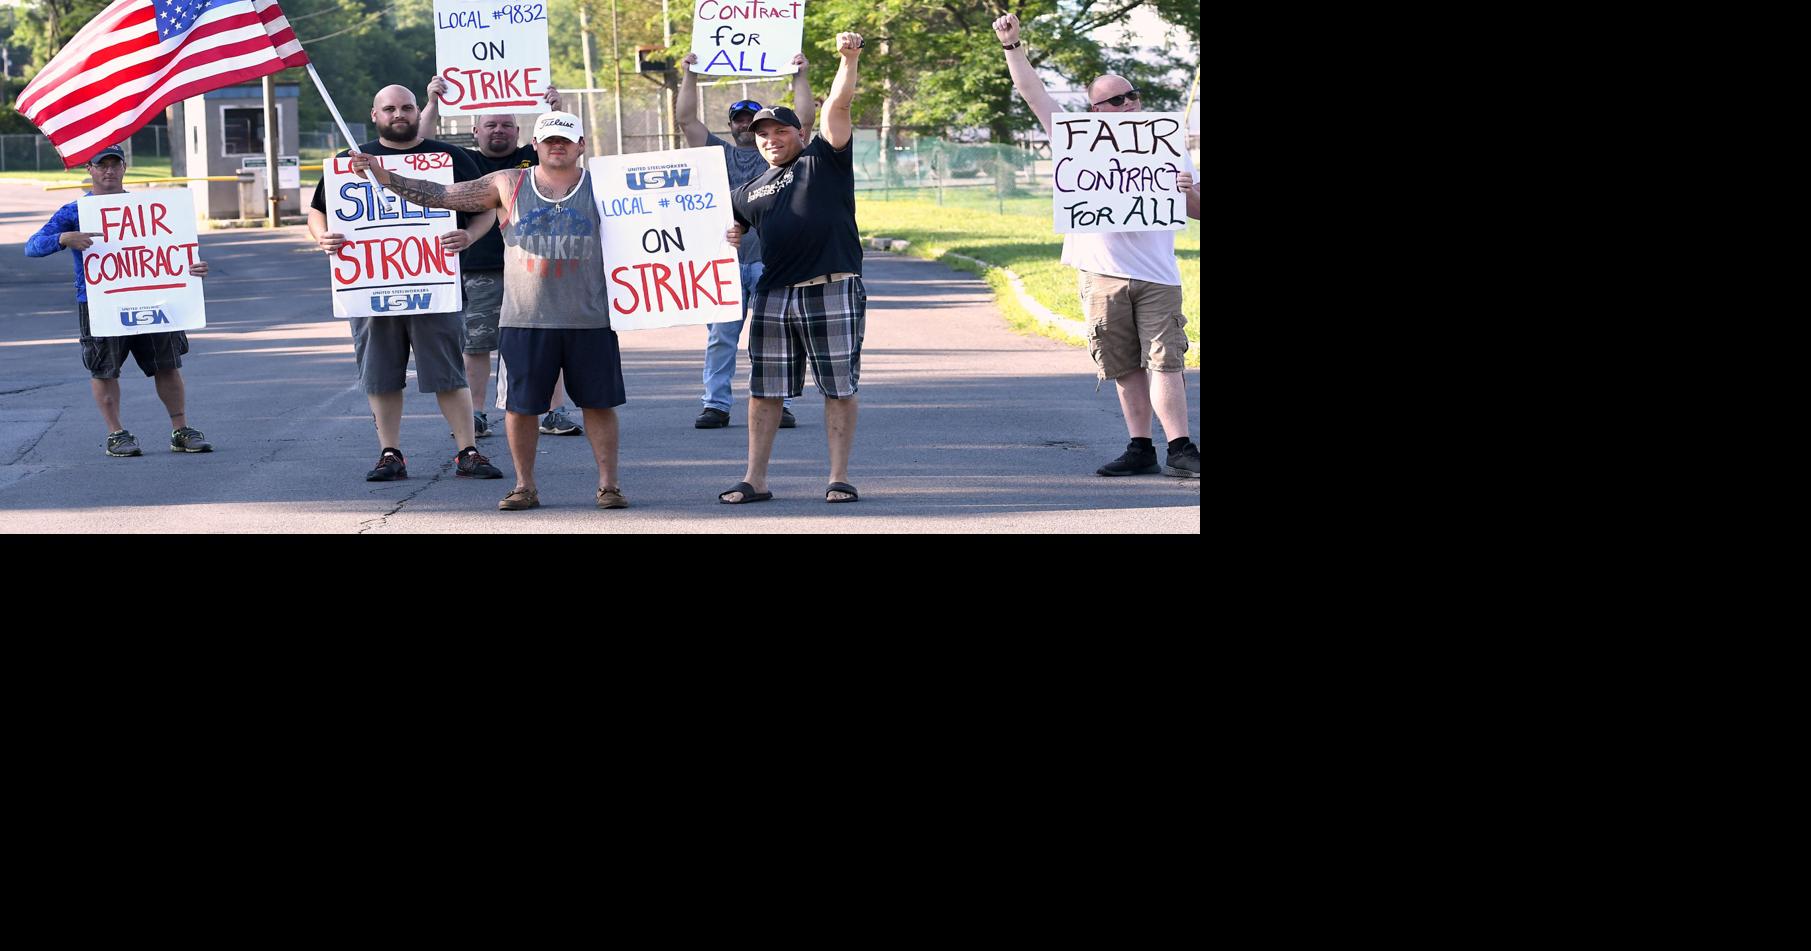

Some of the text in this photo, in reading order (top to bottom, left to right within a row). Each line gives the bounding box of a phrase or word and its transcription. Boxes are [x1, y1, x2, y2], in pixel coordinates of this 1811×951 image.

[438, 11, 490, 29] LOCAL
[472, 40, 505, 60] ON
[704, 49, 777, 72] ALL
[438, 67, 545, 105] STRIKE
[1056, 118, 1181, 157] FAIR
[404, 152, 453, 171] 9832
[1055, 157, 1182, 193] CONTRACT
[626, 168, 691, 190] USW
[602, 197, 653, 217] LOCAL
[675, 192, 717, 212] 9832
[1064, 196, 1186, 228] FOR ALL
[100, 203, 172, 243] FAIR
[642, 226, 685, 254] ON
[84, 243, 198, 285] CONTRACT
[611, 257, 739, 315] STRIKE
[370, 293, 432, 313] USW
